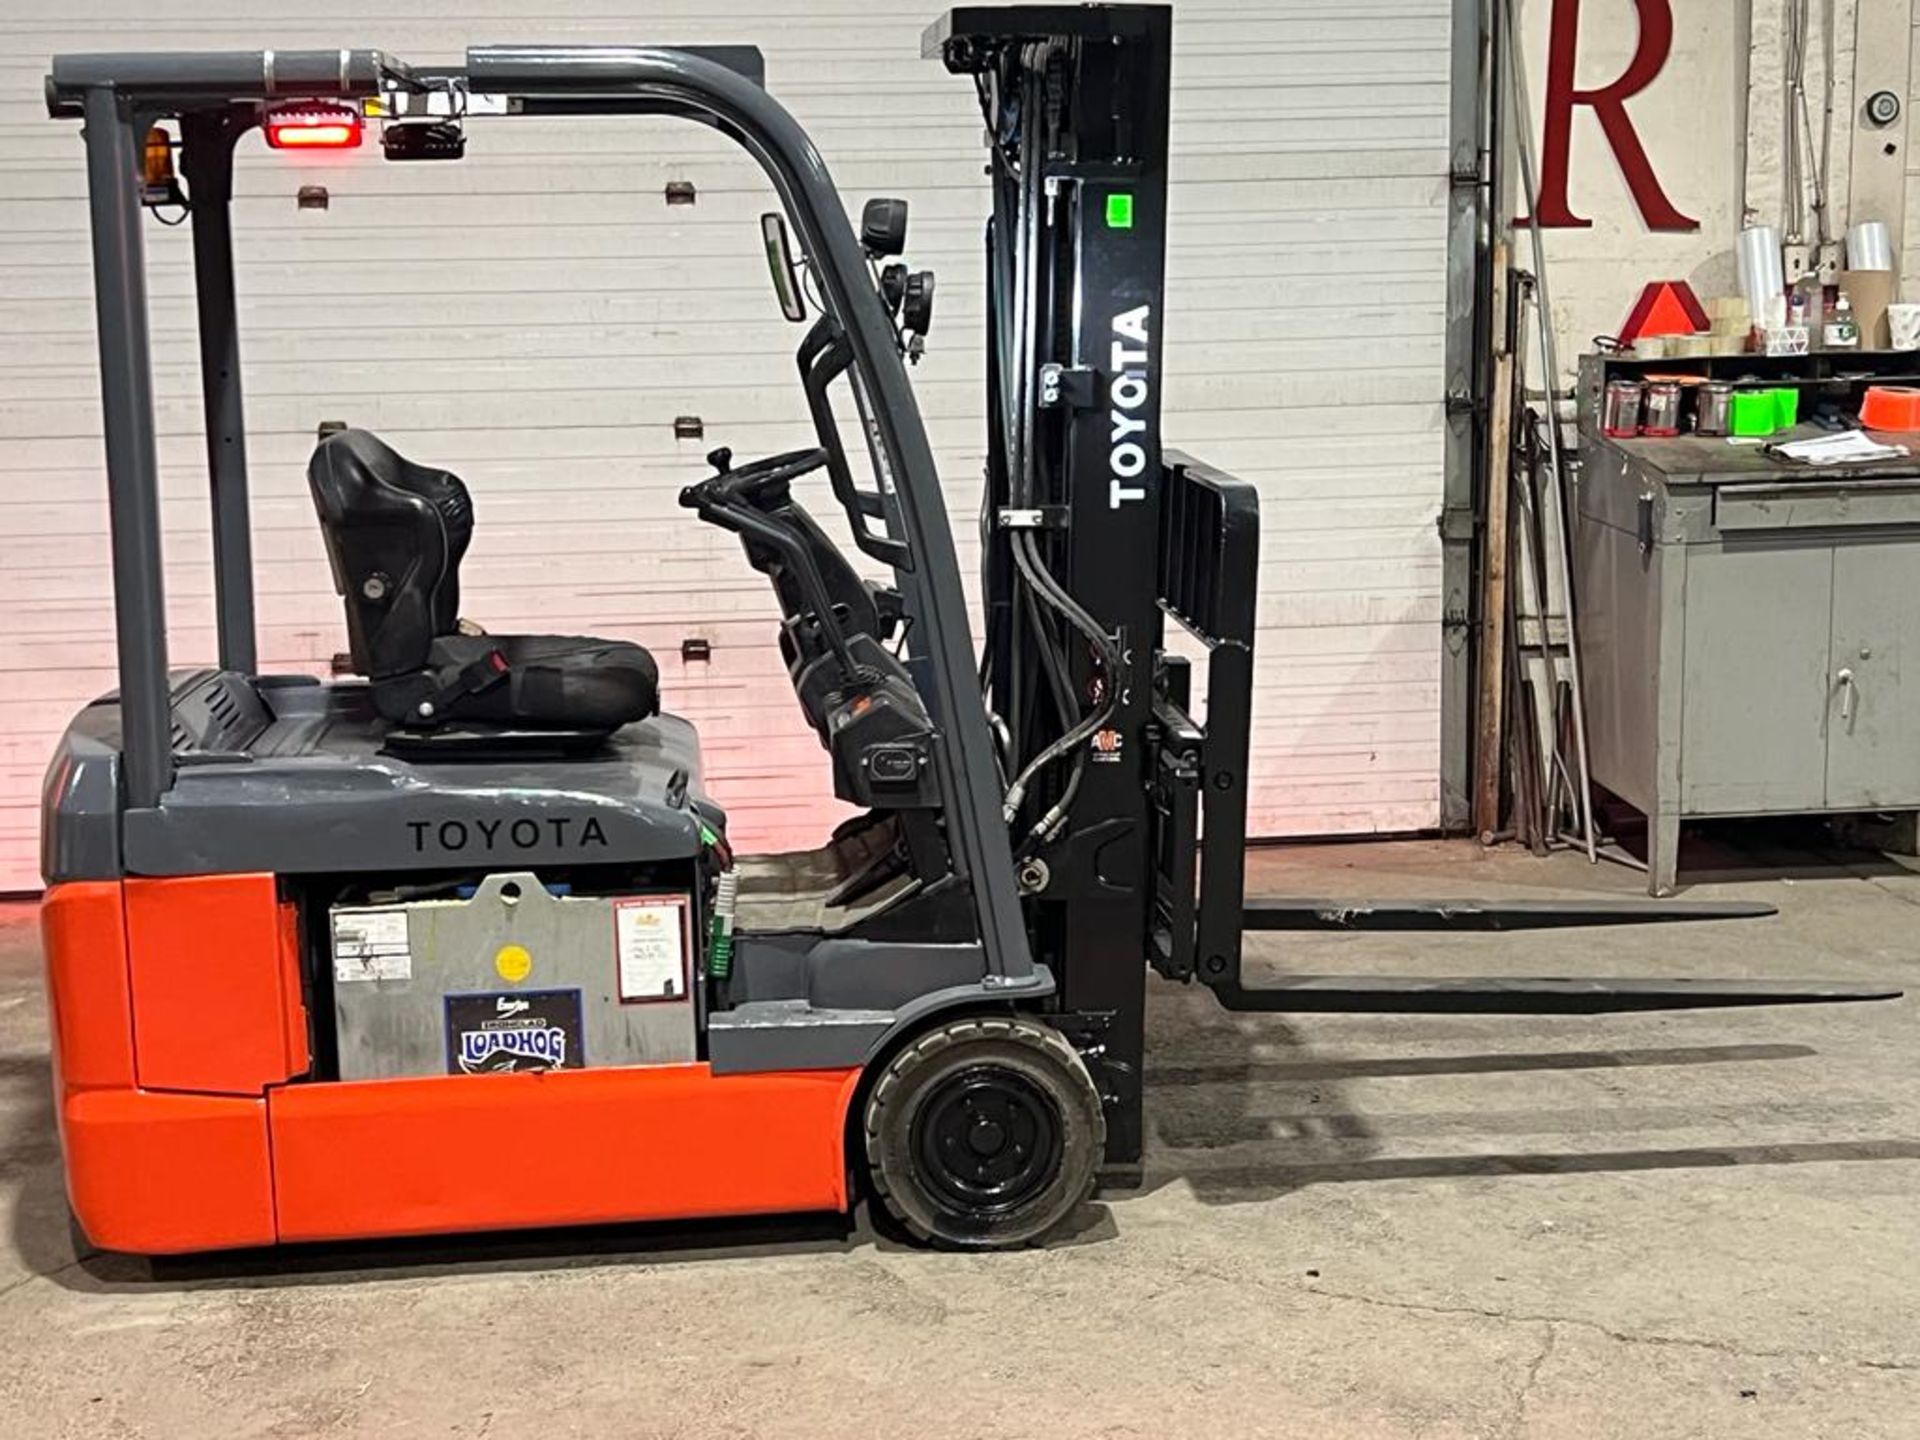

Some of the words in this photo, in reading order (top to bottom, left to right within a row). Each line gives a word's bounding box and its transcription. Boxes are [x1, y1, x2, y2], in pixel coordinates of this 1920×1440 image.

[1513, 0, 1699, 232] R
[1110, 305, 1149, 509] TOYOTA
[406, 817, 608, 851] TOYOTA
[463, 1028, 565, 1063] LOADHOG
